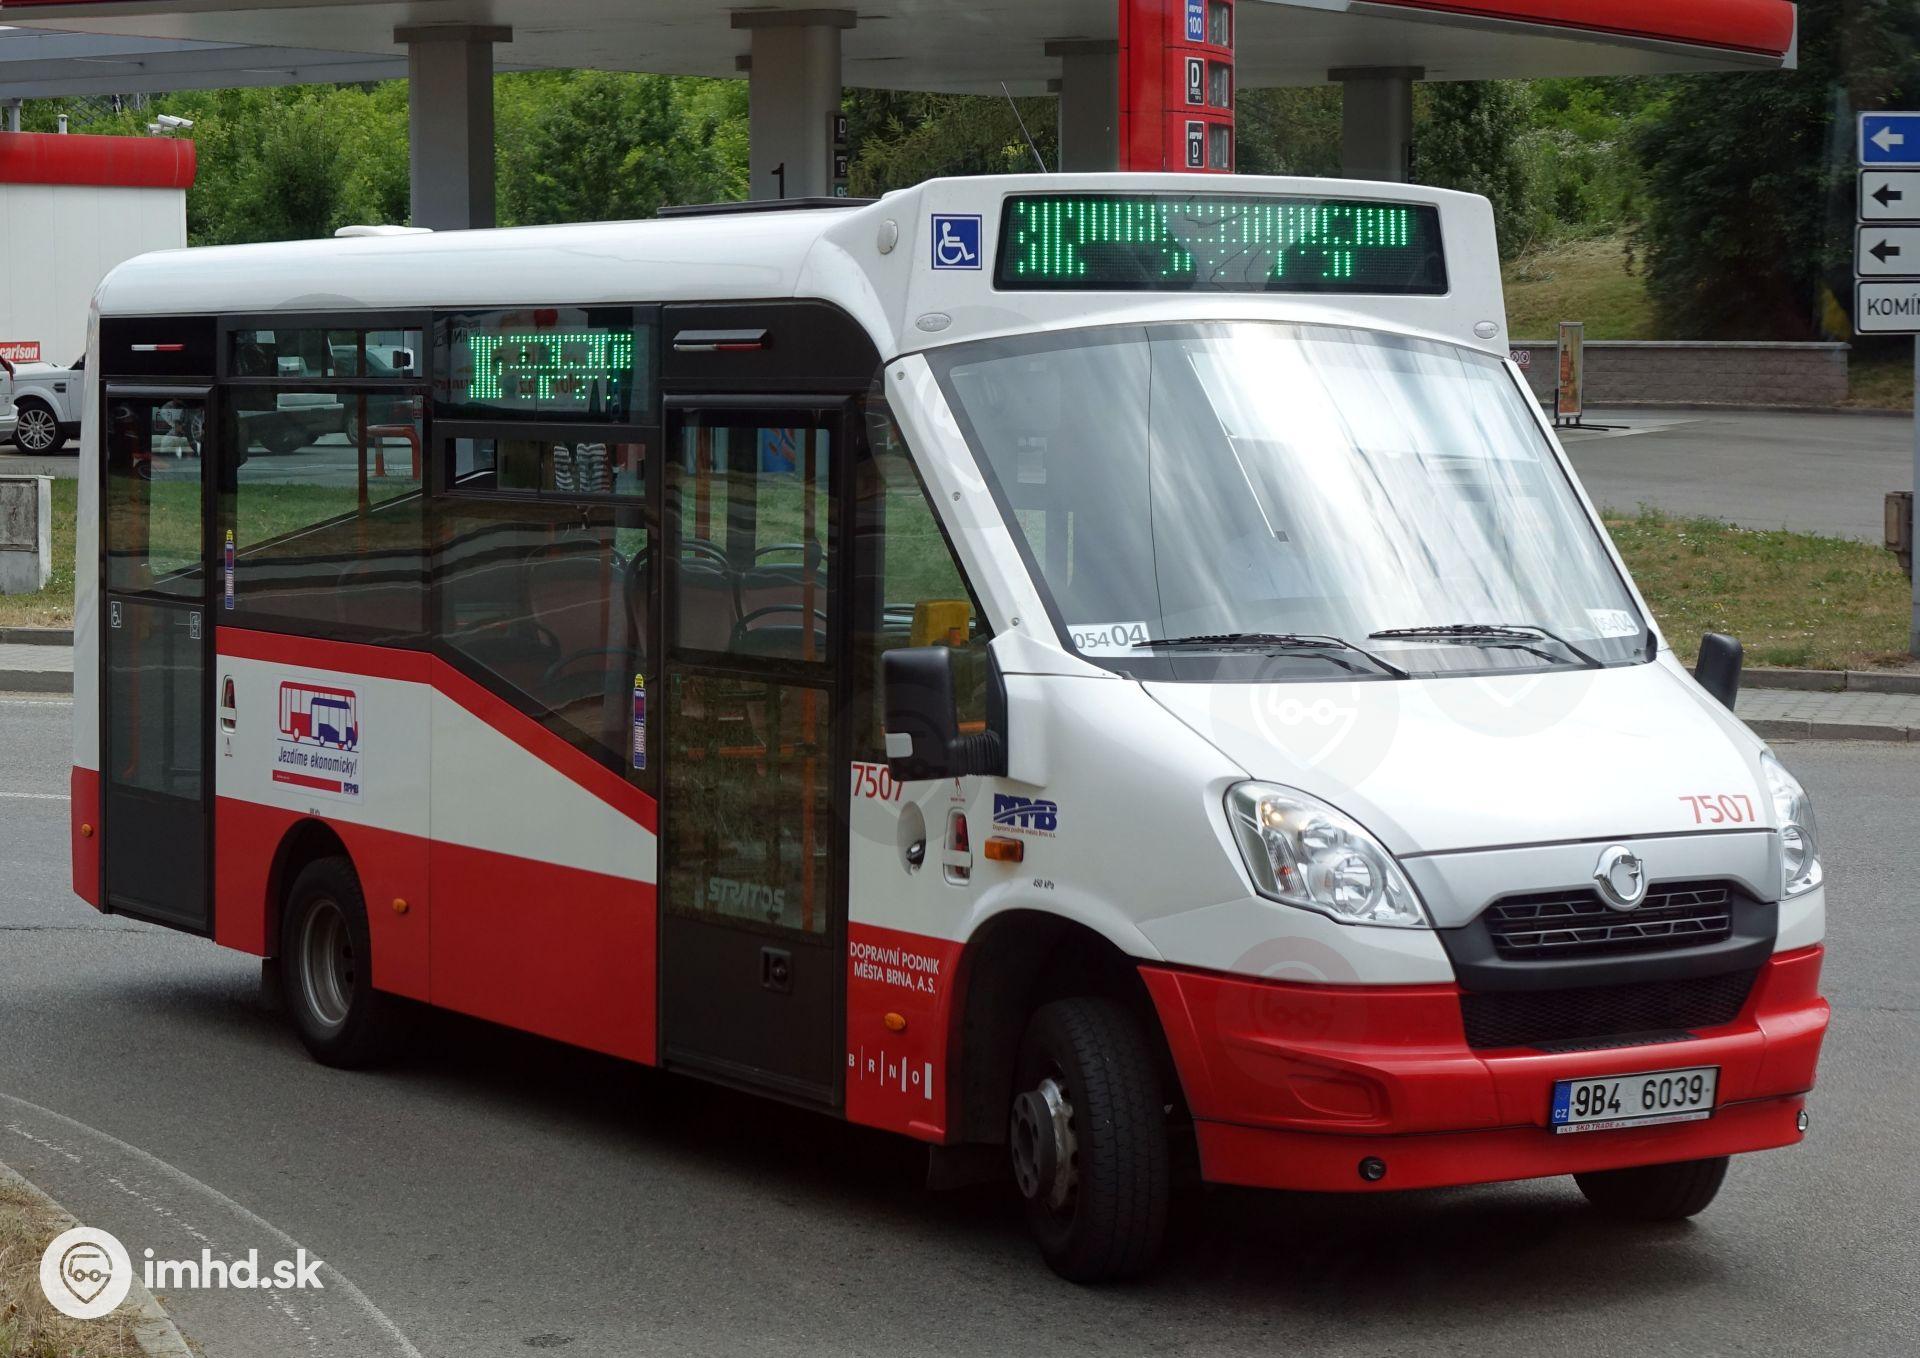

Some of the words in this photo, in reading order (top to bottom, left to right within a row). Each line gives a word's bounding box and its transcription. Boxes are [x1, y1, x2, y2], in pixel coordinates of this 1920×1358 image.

[1189, 16, 1202, 34] 100
[1191, 62, 1200, 88] D
[840, 118, 847, 134] D
[1192, 141, 1199, 158] D
[1867, 292, 1920, 316] KOMÍ
[278, 746, 308, 767] Jezdíme
[310, 752, 358, 778] ekonomicky!
[1678, 794, 1755, 824] 7507
[850, 941, 900, 965] DOPRAVNÍ
[902, 953, 939, 975] PODNIK
[854, 960, 884, 982] MĚSTA
[886, 971, 915, 991] BRNA,
[917, 977, 936, 994] A.S.
[1555, 1108, 1568, 1119] CZ
[1575, 1082, 1621, 1117] 9B4
[1642, 1074, 1703, 1110] 6039
